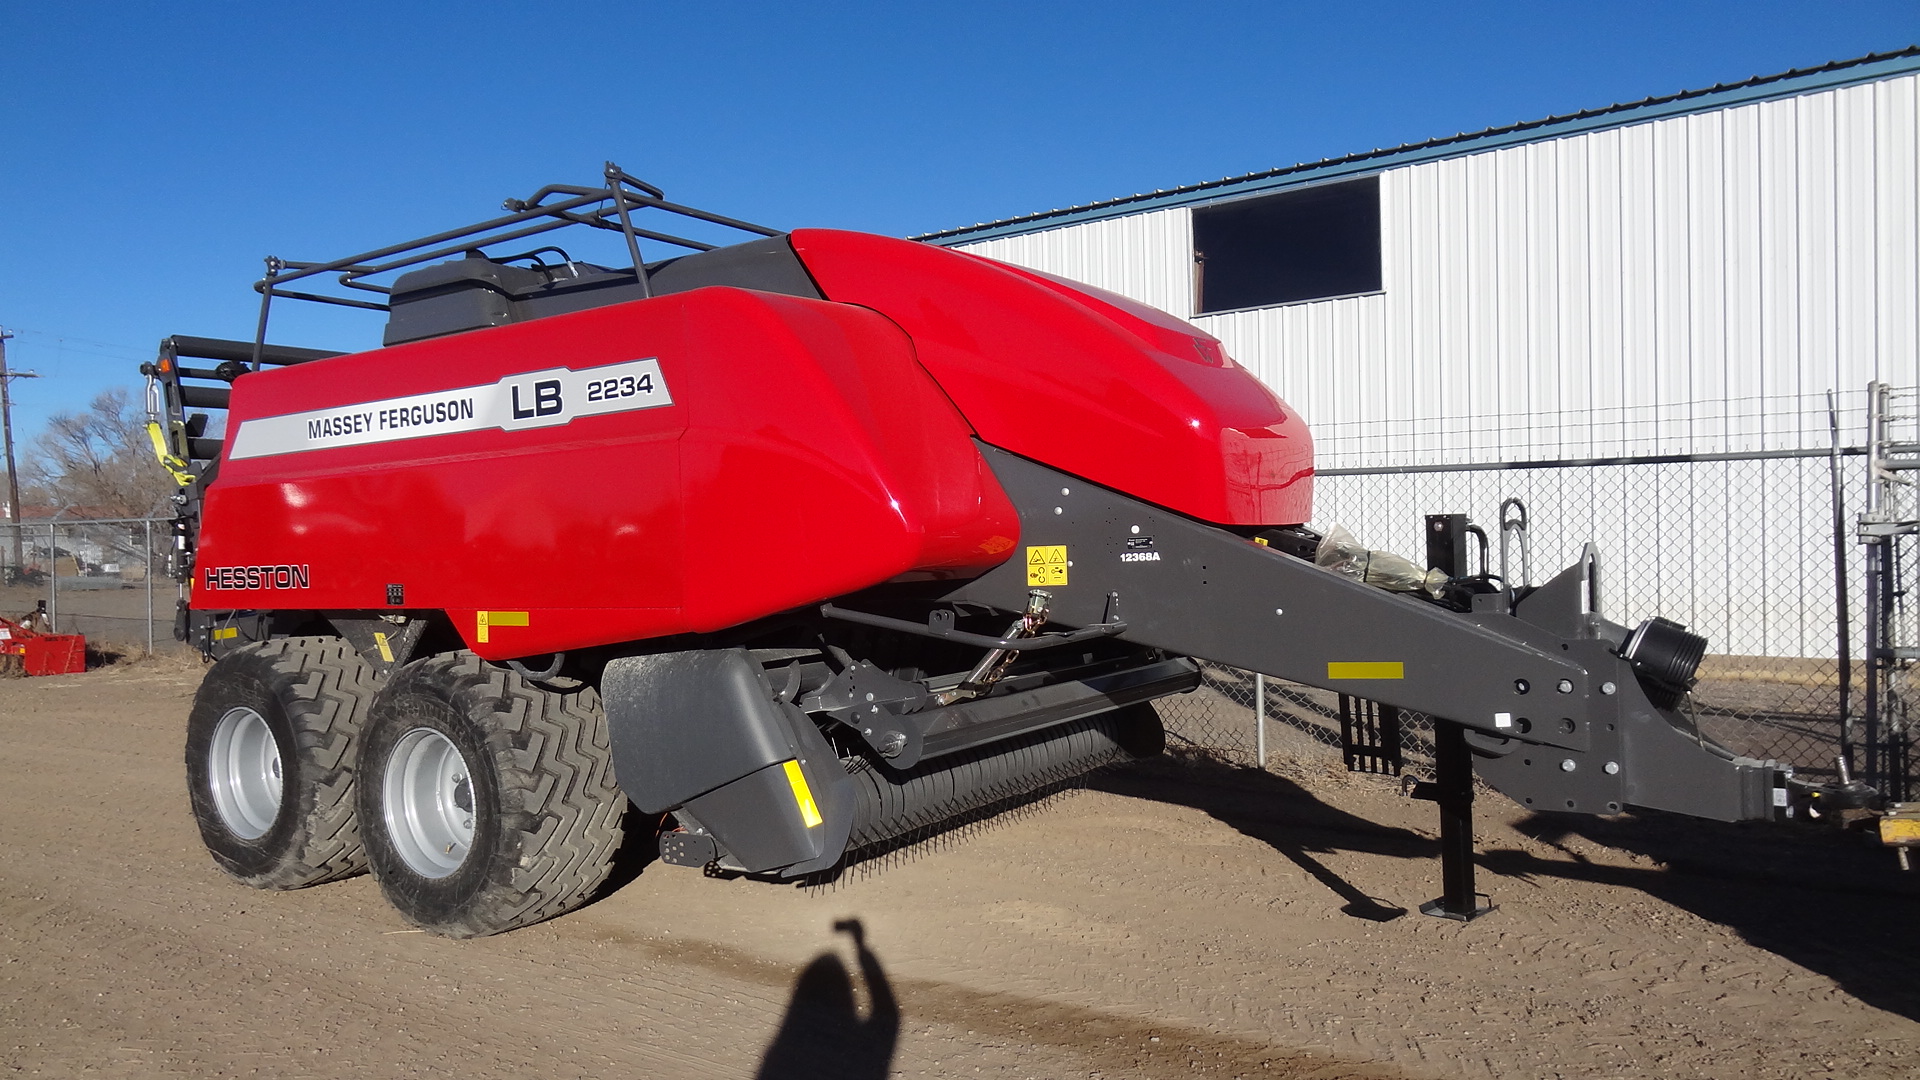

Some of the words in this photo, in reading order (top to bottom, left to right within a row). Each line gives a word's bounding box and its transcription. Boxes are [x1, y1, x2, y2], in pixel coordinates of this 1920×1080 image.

[308, 412, 373, 440] MASSEY
[379, 398, 474, 431] FERGUSON
[511, 378, 564, 420] LB
[587, 373, 654, 402] 2234
[1120, 552, 1161, 562] 12368A
[205, 564, 310, 590] HESSTON
